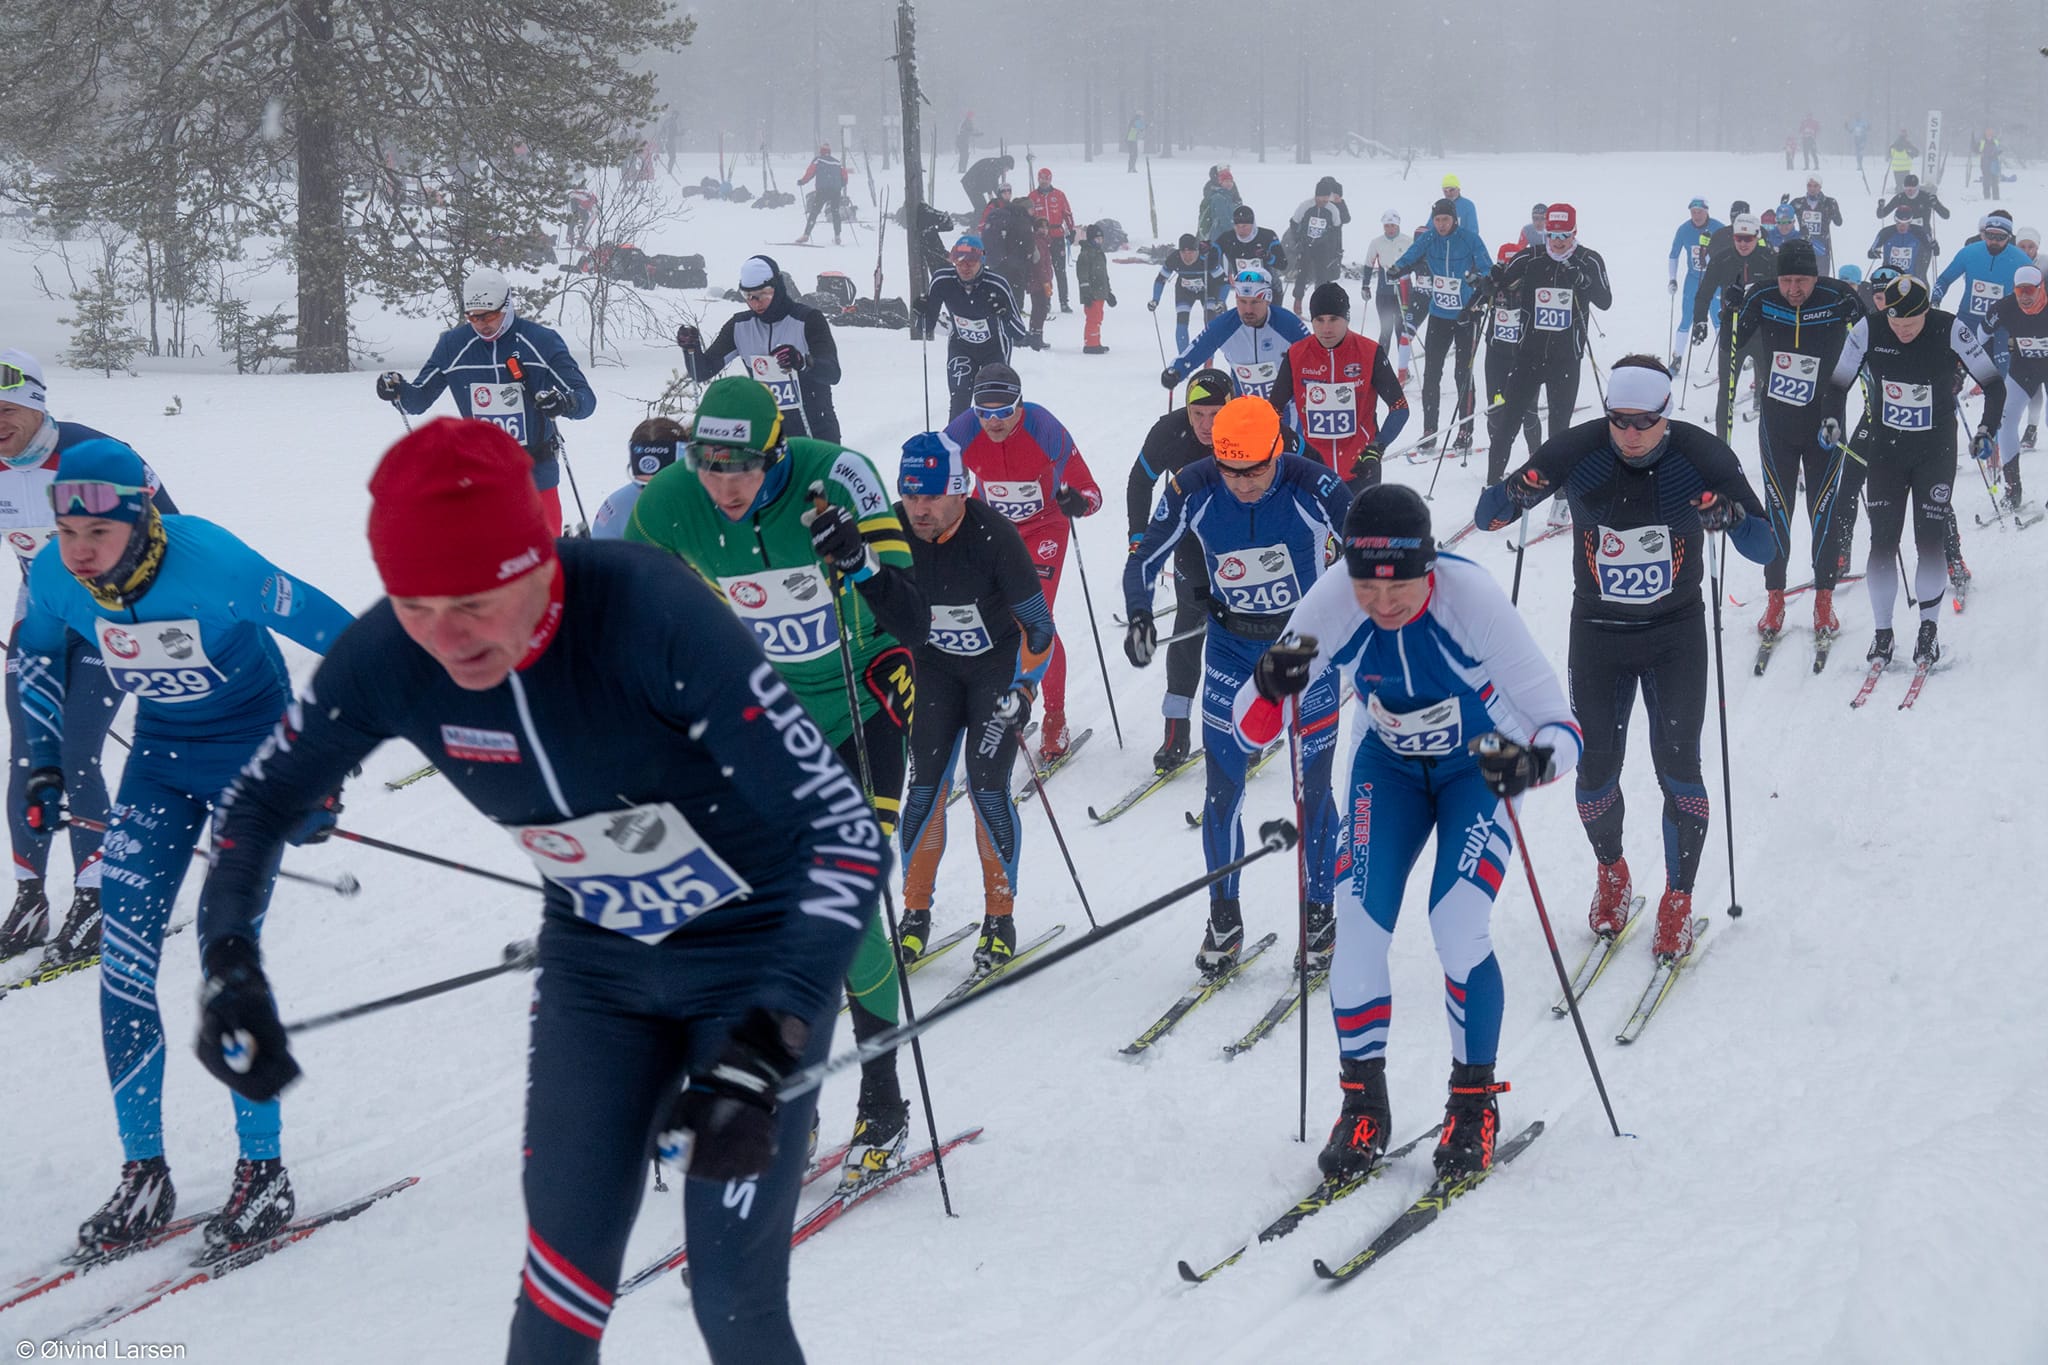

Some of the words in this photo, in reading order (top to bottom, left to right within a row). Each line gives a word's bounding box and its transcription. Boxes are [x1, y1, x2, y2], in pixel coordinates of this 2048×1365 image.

[1928, 117, 1939, 174] START
[1436, 294, 1458, 308] 238
[1539, 310, 1569, 326] 201
[1803, 311, 1827, 321] CRAFT
[960, 329, 987, 342] 243
[770, 383, 795, 405] 34
[1773, 374, 1809, 401] 222
[1313, 412, 1350, 433] 213
[1888, 405, 1923, 426] 221
[834, 463, 867, 494] SWECO
[995, 502, 1036, 519] 223
[1607, 565, 1663, 595] 229
[1232, 581, 1291, 609] 246
[755, 610, 829, 654] 207
[928, 631, 981, 651] 228
[124, 669, 210, 698] 239
[1378, 730, 1451, 752] 242
[1352, 797, 1371, 900] INTERSPORT
[580, 864, 718, 930] 245
